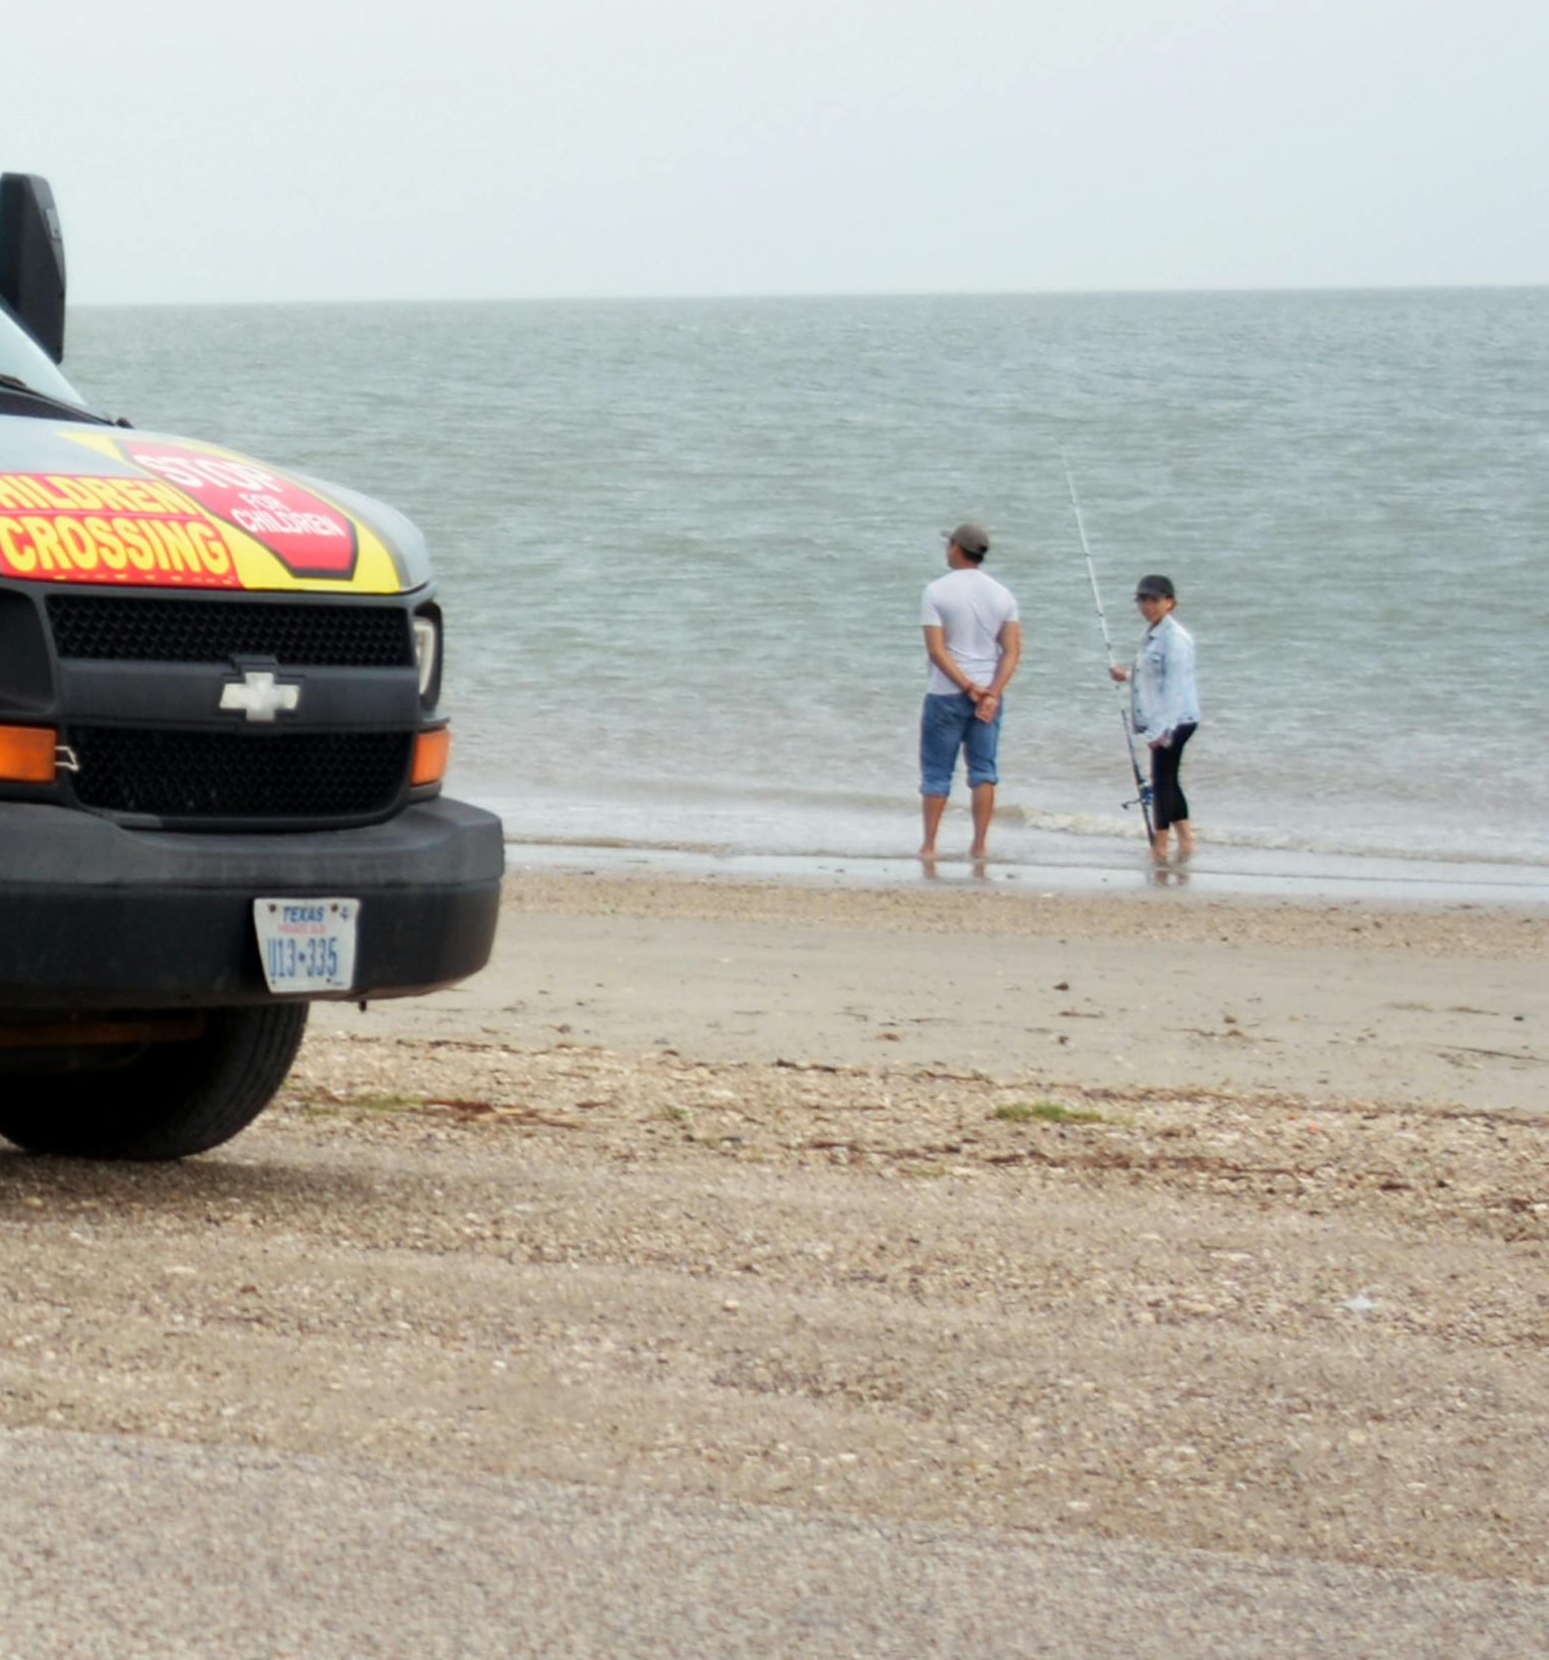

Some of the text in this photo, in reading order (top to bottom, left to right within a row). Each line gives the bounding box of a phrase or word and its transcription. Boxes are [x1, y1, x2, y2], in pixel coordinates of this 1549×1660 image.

[132, 454, 283, 492] STOP
[241, 492, 294, 513] FOR
[230, 508, 346, 538] CHILDREN
[283, 906, 325, 922] TEXAS
